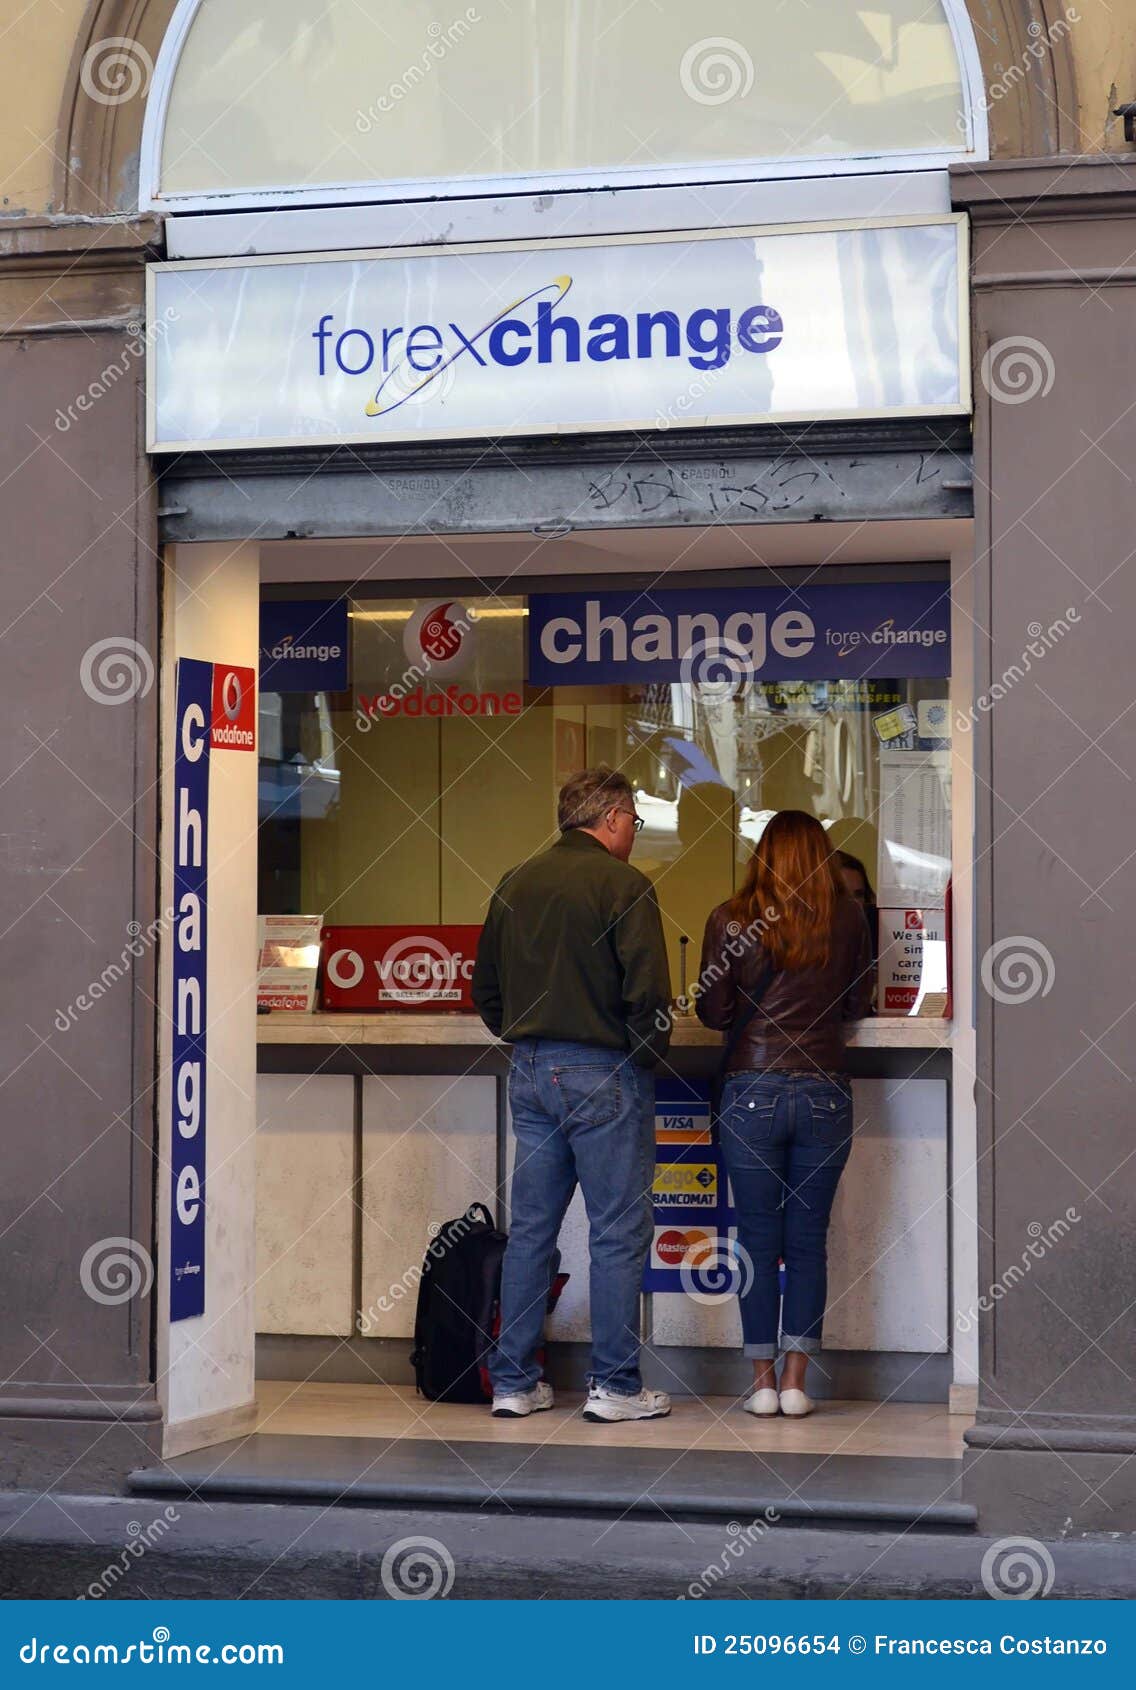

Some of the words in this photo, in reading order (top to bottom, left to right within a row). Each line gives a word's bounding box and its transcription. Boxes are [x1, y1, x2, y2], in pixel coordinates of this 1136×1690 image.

[312, 302, 784, 376] forexchange
[540, 600, 816, 673] change
[358, 684, 522, 717] vodafone
[212, 724, 254, 745] vodafone
[892, 931, 913, 940] We
[916, 931, 938, 941] sell
[176, 703, 205, 1226] change
[374, 952, 476, 981] vodafo
[892, 972, 921, 982] here
[663, 1117, 694, 1129] VISA
[653, 1193, 715, 1204] BANCOMAT
